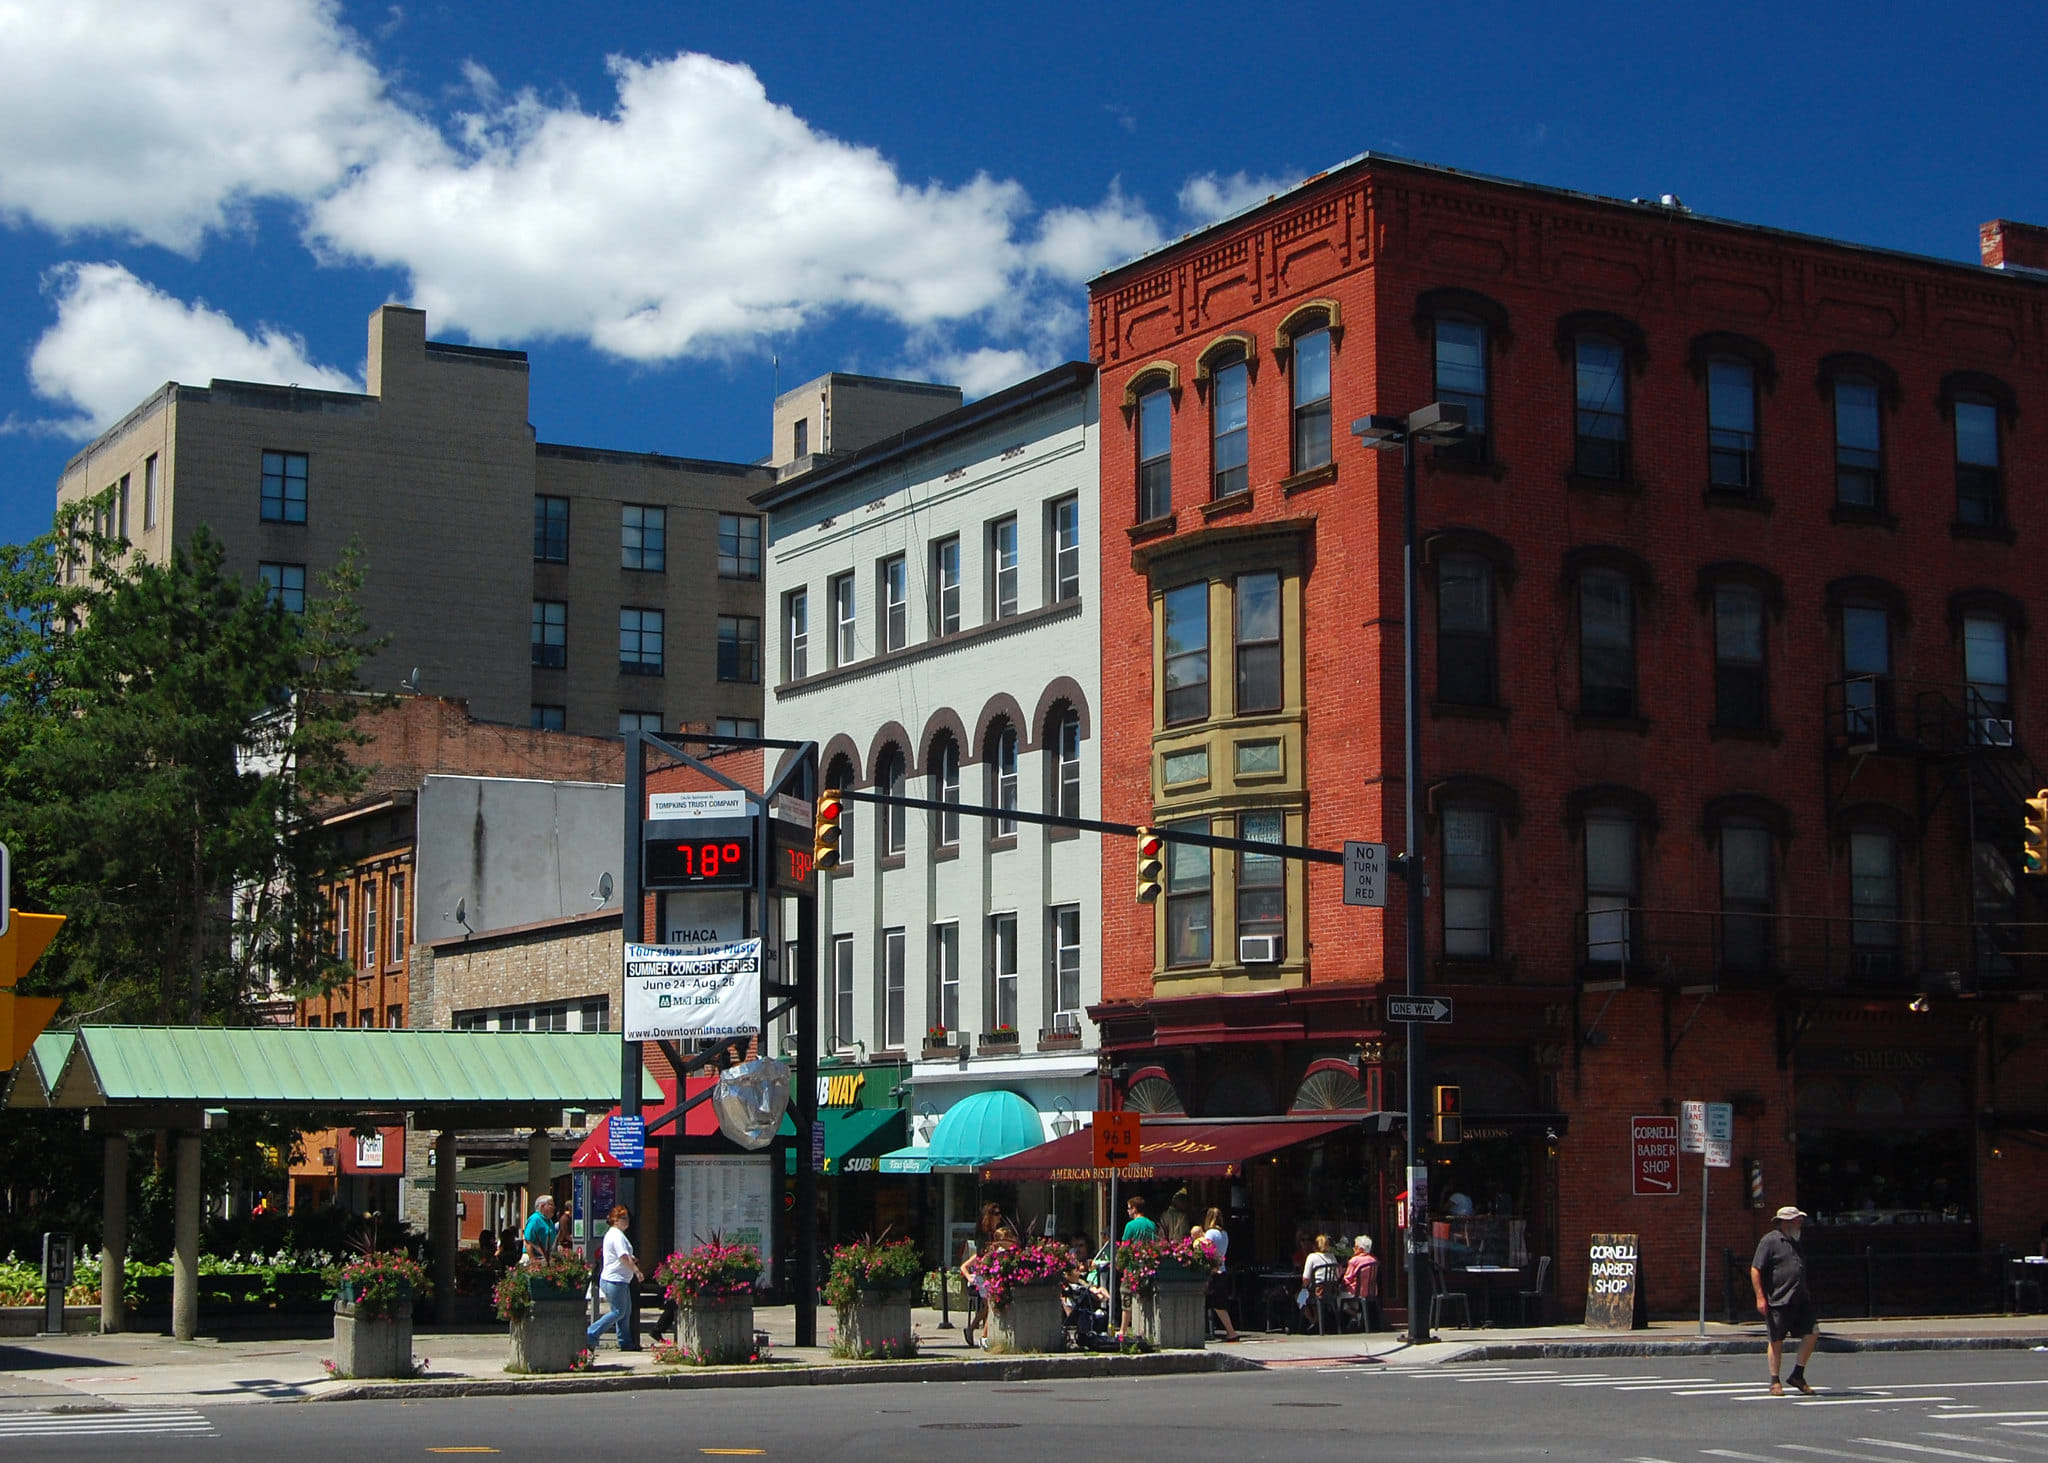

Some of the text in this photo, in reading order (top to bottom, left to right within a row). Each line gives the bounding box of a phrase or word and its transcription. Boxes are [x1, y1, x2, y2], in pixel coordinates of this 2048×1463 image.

[655, 799, 739, 810] TOMPKINS TRUST COMPANY
[1356, 847, 1374, 860] NO
[1353, 861, 1378, 873] TURN
[1359, 875, 1372, 886] ON
[1355, 888, 1374, 899] RED
[671, 929, 718, 942] ITHACA
[629, 946, 682, 957] Thursday
[697, 944, 720, 955] Live
[724, 943, 757, 954] Music
[629, 958, 755, 977] SUMMER CONCERT SERIES
[643, 979, 671, 991] June
[673, 979, 685, 989] 24
[693, 979, 720, 991] Aug.
[722, 977, 735, 988] 26
[695, 995, 721, 1006] Bank
[1393, 1002, 1434, 1015] ONE WAY
[627, 1025, 758, 1039] www.DowntownIthaca.com
[817, 1072, 865, 1105] BWAY
[1684, 1112, 1703, 1121] LANE
[1634, 1126, 1677, 1139] CORNELL
[1688, 1123, 1699, 1131] NO
[1103, 1130, 1131, 1145] 96 B
[1637, 1144, 1676, 1157] BARBER
[1050, 1167, 1091, 1180] AMERICAN
[1121, 1166, 1154, 1178] CUISINE
[1642, 1160, 1670, 1174] SHOP
[1590, 1245, 1637, 1260] CORNELL
[1592, 1262, 1634, 1276] BARBER
[1595, 1279, 1628, 1293] SHOP
